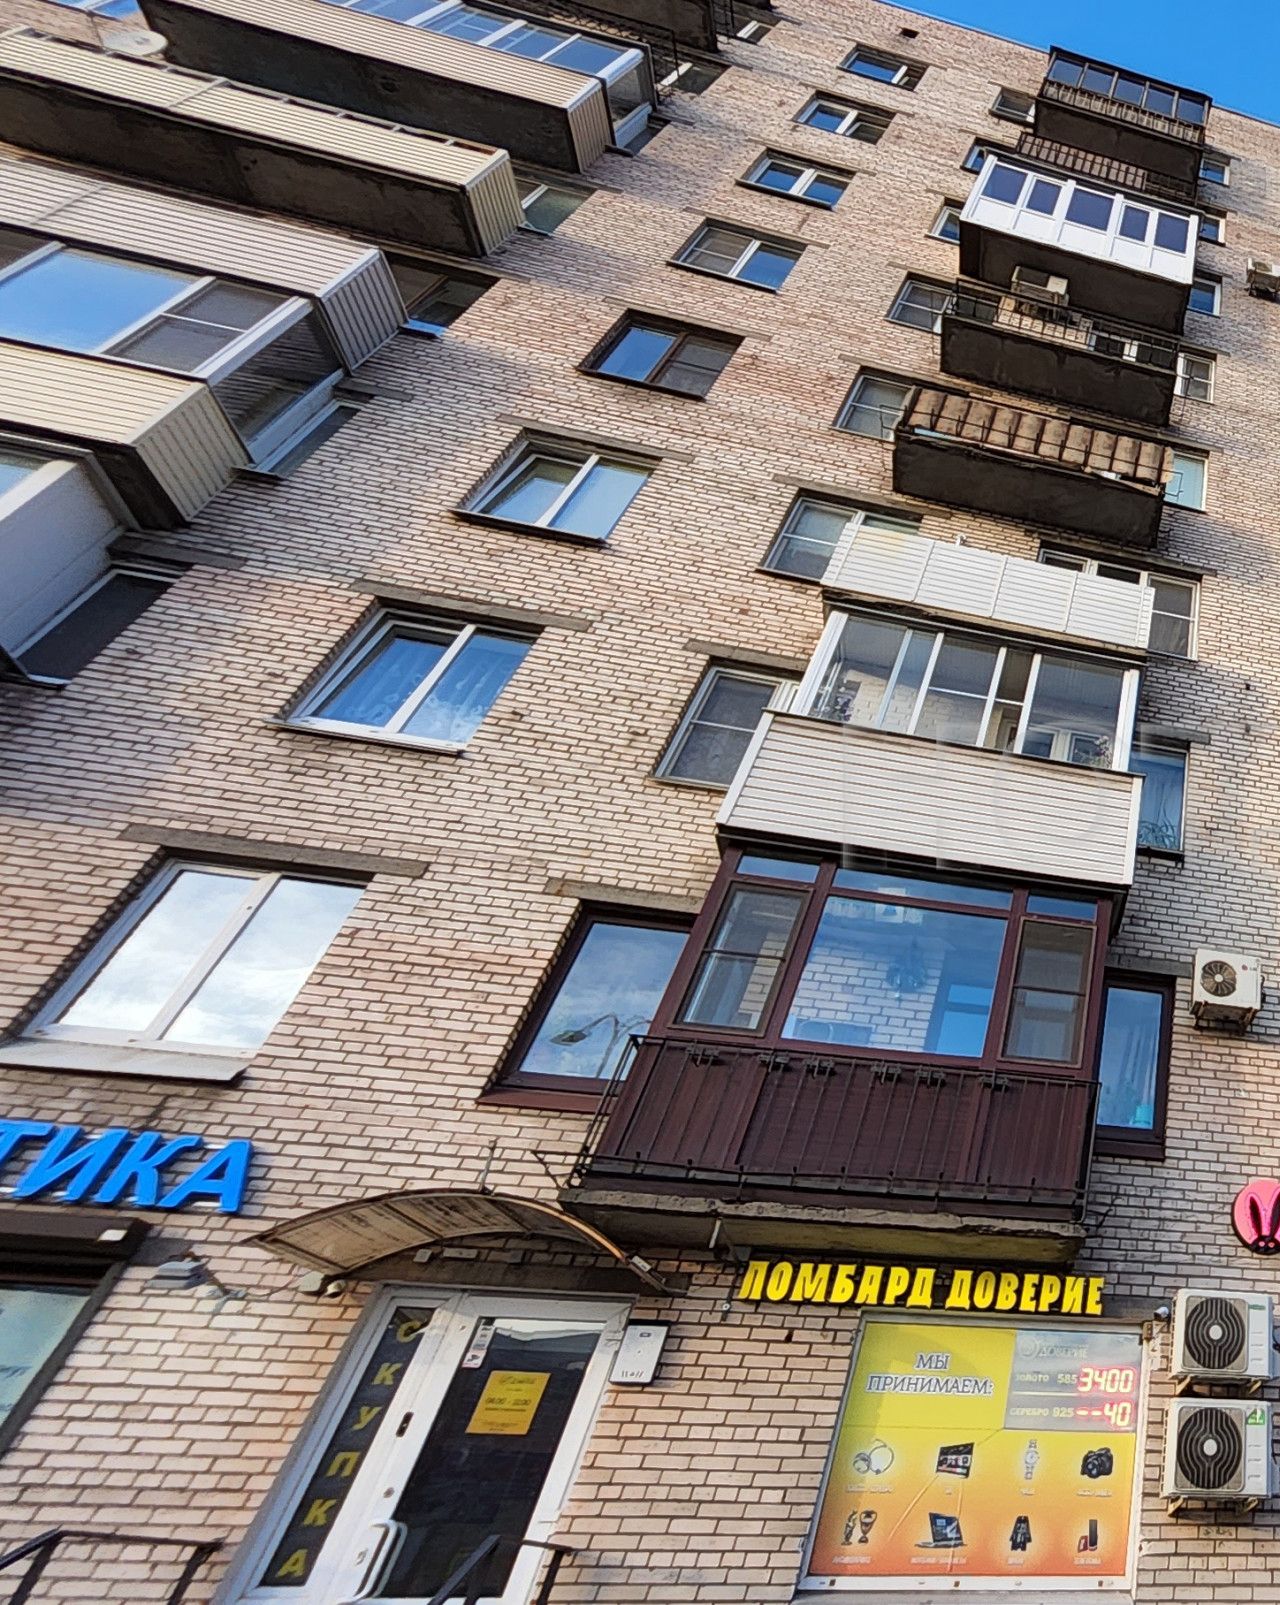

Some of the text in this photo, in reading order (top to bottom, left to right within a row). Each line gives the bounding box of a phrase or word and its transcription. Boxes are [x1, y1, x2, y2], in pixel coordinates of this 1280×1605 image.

[738, 1260, 1105, 1316] ЛОМБАРД ДОВЕРИЕ
[915, 1353, 950, 1371] МЫ
[866, 1374, 995, 1396] ПРИНИМАЕМ:
[1057, 1373, 1078, 1385] 585
[1077, 1367, 1134, 1393] 3400
[1052, 1406, 1075, 1418] 925
[275, 1320, 421, 1578] СКУПКА
